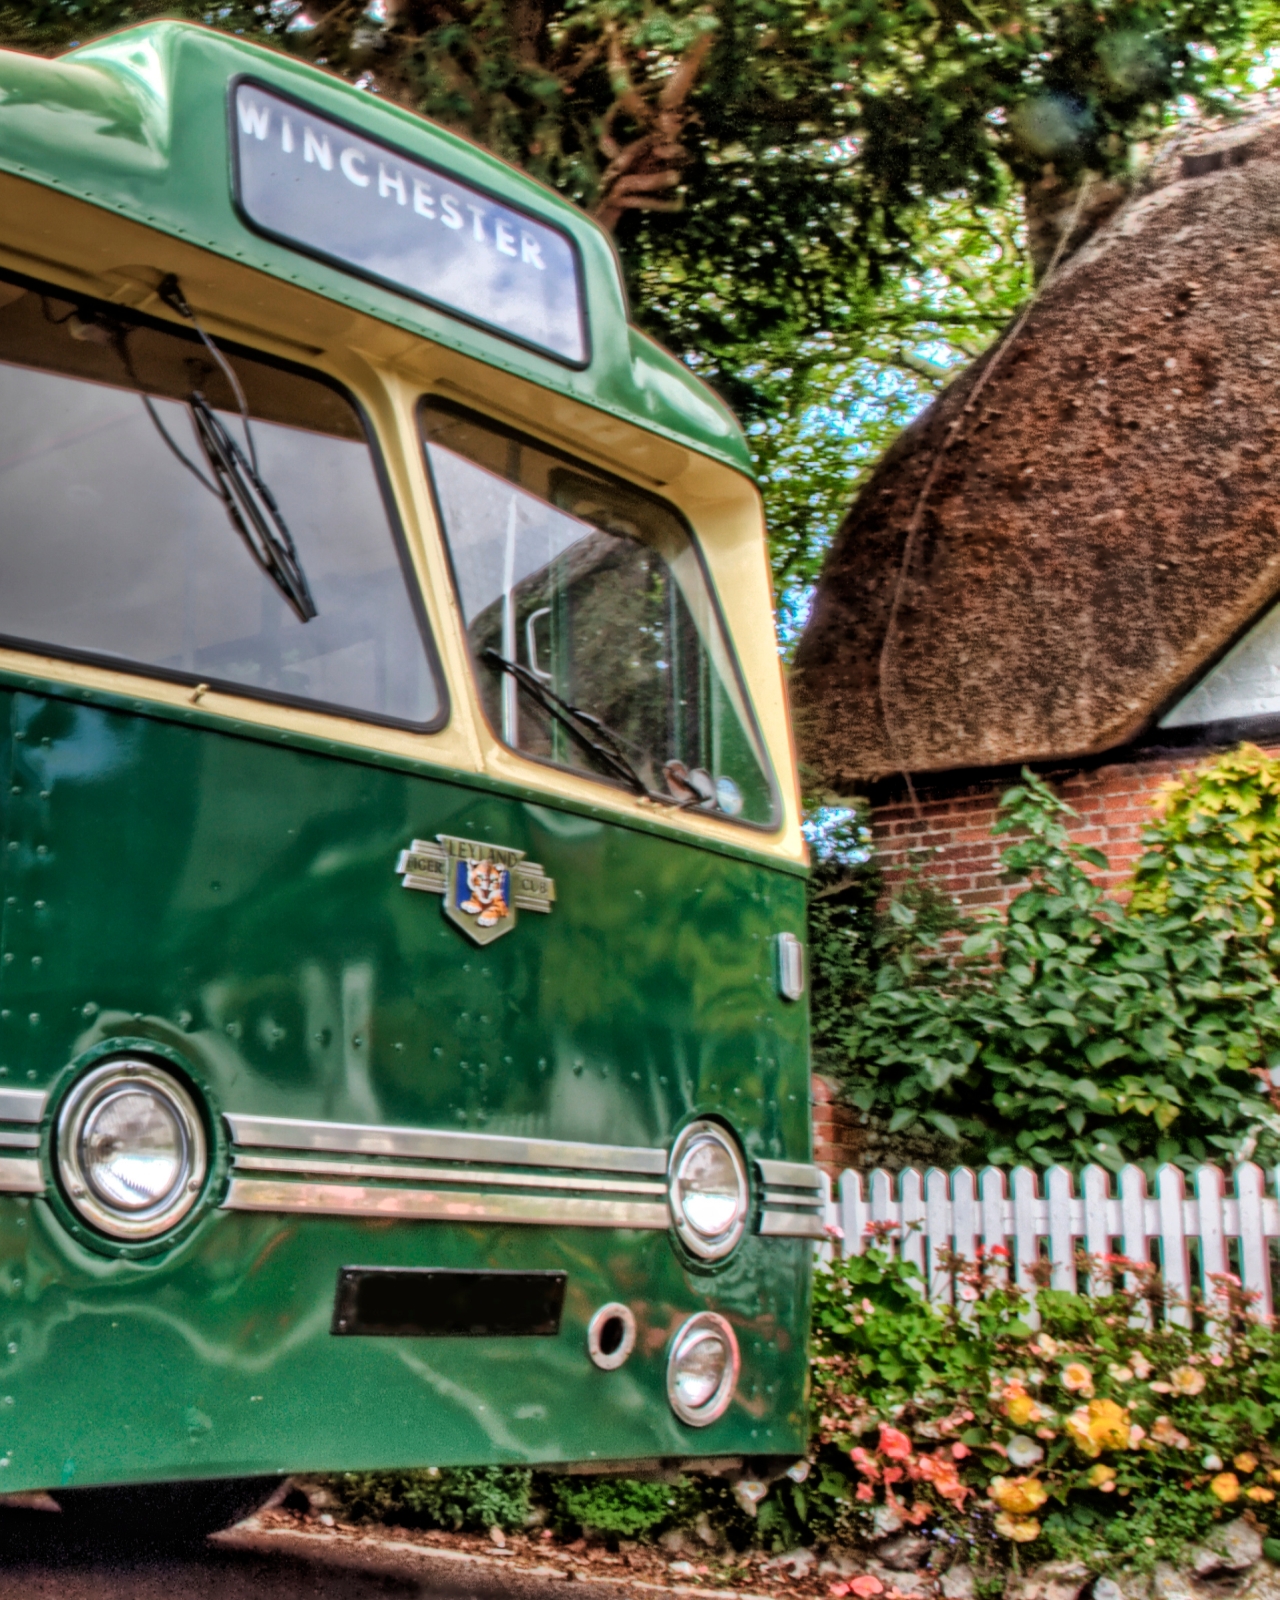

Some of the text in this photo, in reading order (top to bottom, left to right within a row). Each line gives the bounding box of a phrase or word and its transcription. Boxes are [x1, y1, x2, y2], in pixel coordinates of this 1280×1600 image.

[236, 101, 547, 271] WINCHESTER
[405, 855, 444, 875] TIGER
[447, 840, 519, 869] LEYLAND
